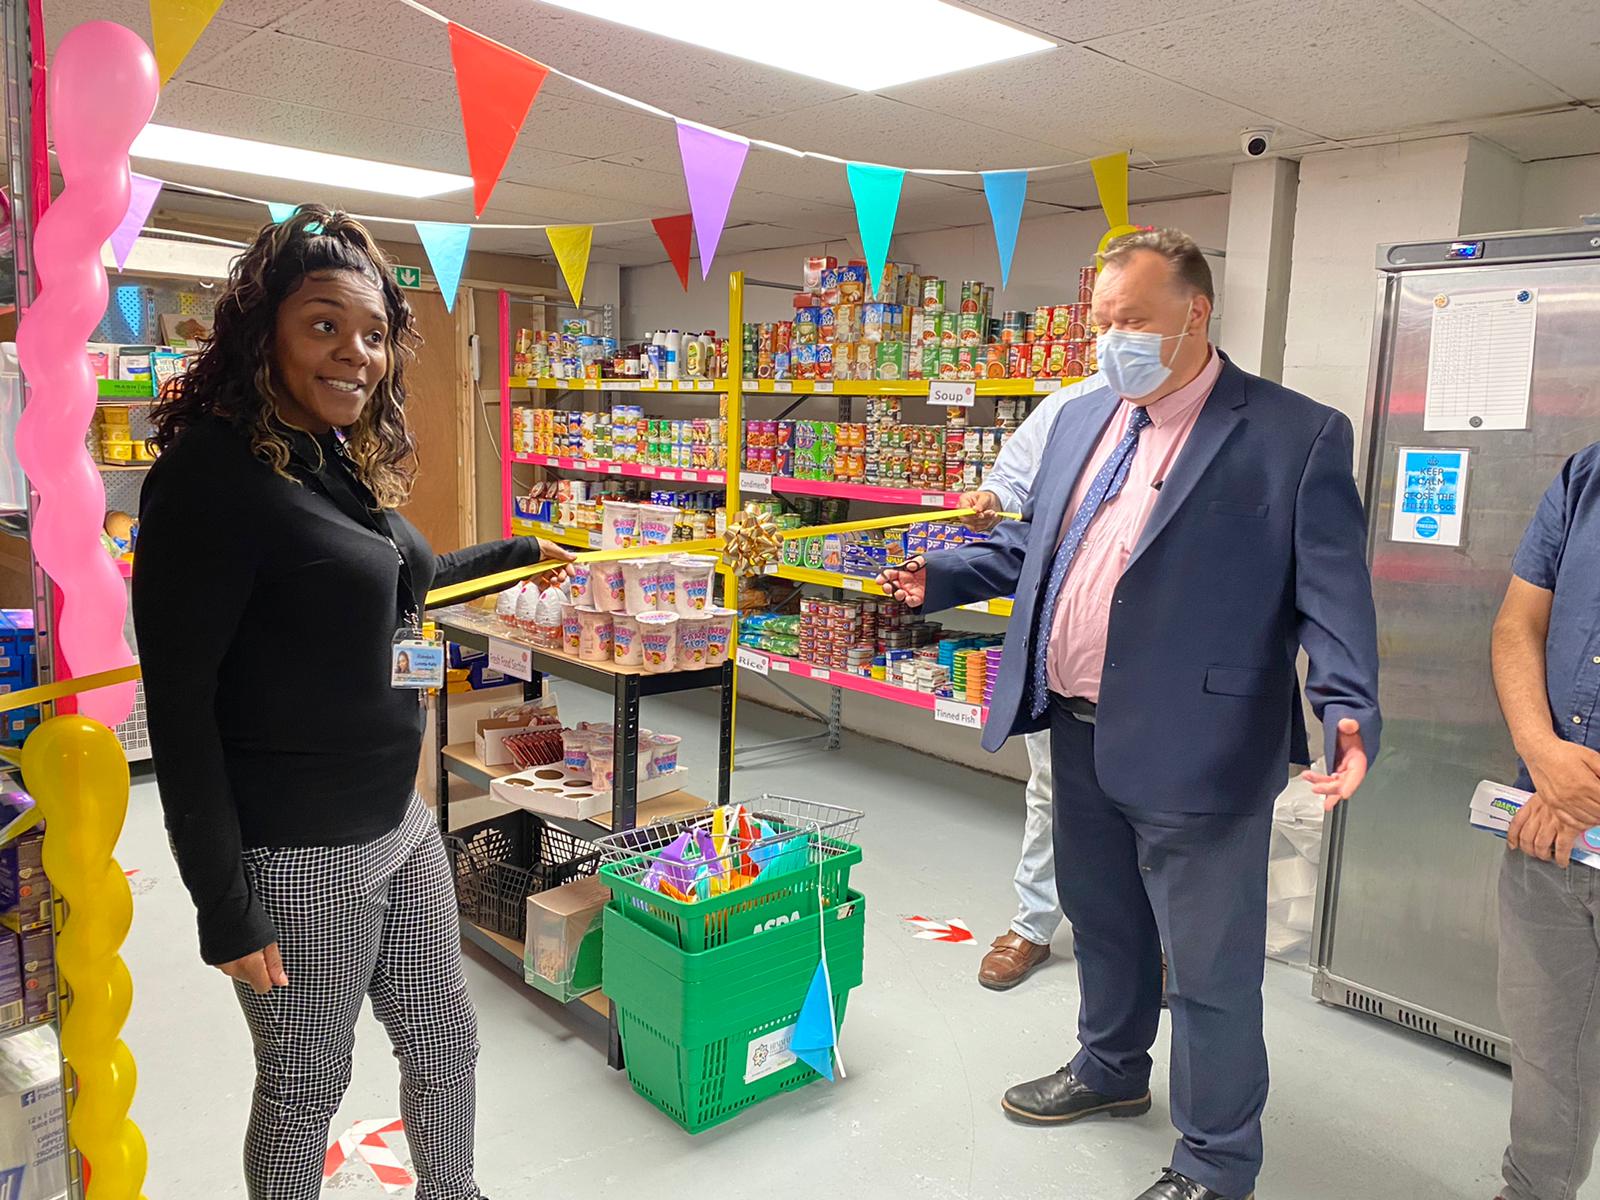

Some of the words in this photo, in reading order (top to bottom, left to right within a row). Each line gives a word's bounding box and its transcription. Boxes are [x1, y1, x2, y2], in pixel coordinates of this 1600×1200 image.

[934, 390, 964, 403] Soup
[1420, 467, 1445, 476] KEEP
[1417, 477, 1446, 486] CALM
[1403, 491, 1434, 500] CLOSE
[1436, 492, 1455, 502] THE
[1433, 503, 1457, 512] DOOR
[641, 634, 672, 643] CANDY
[643, 642, 668, 652] FLOSS
[739, 656, 764, 671] Rice
[937, 709, 960, 721] Tinned
[961, 713, 976, 724] Fish
